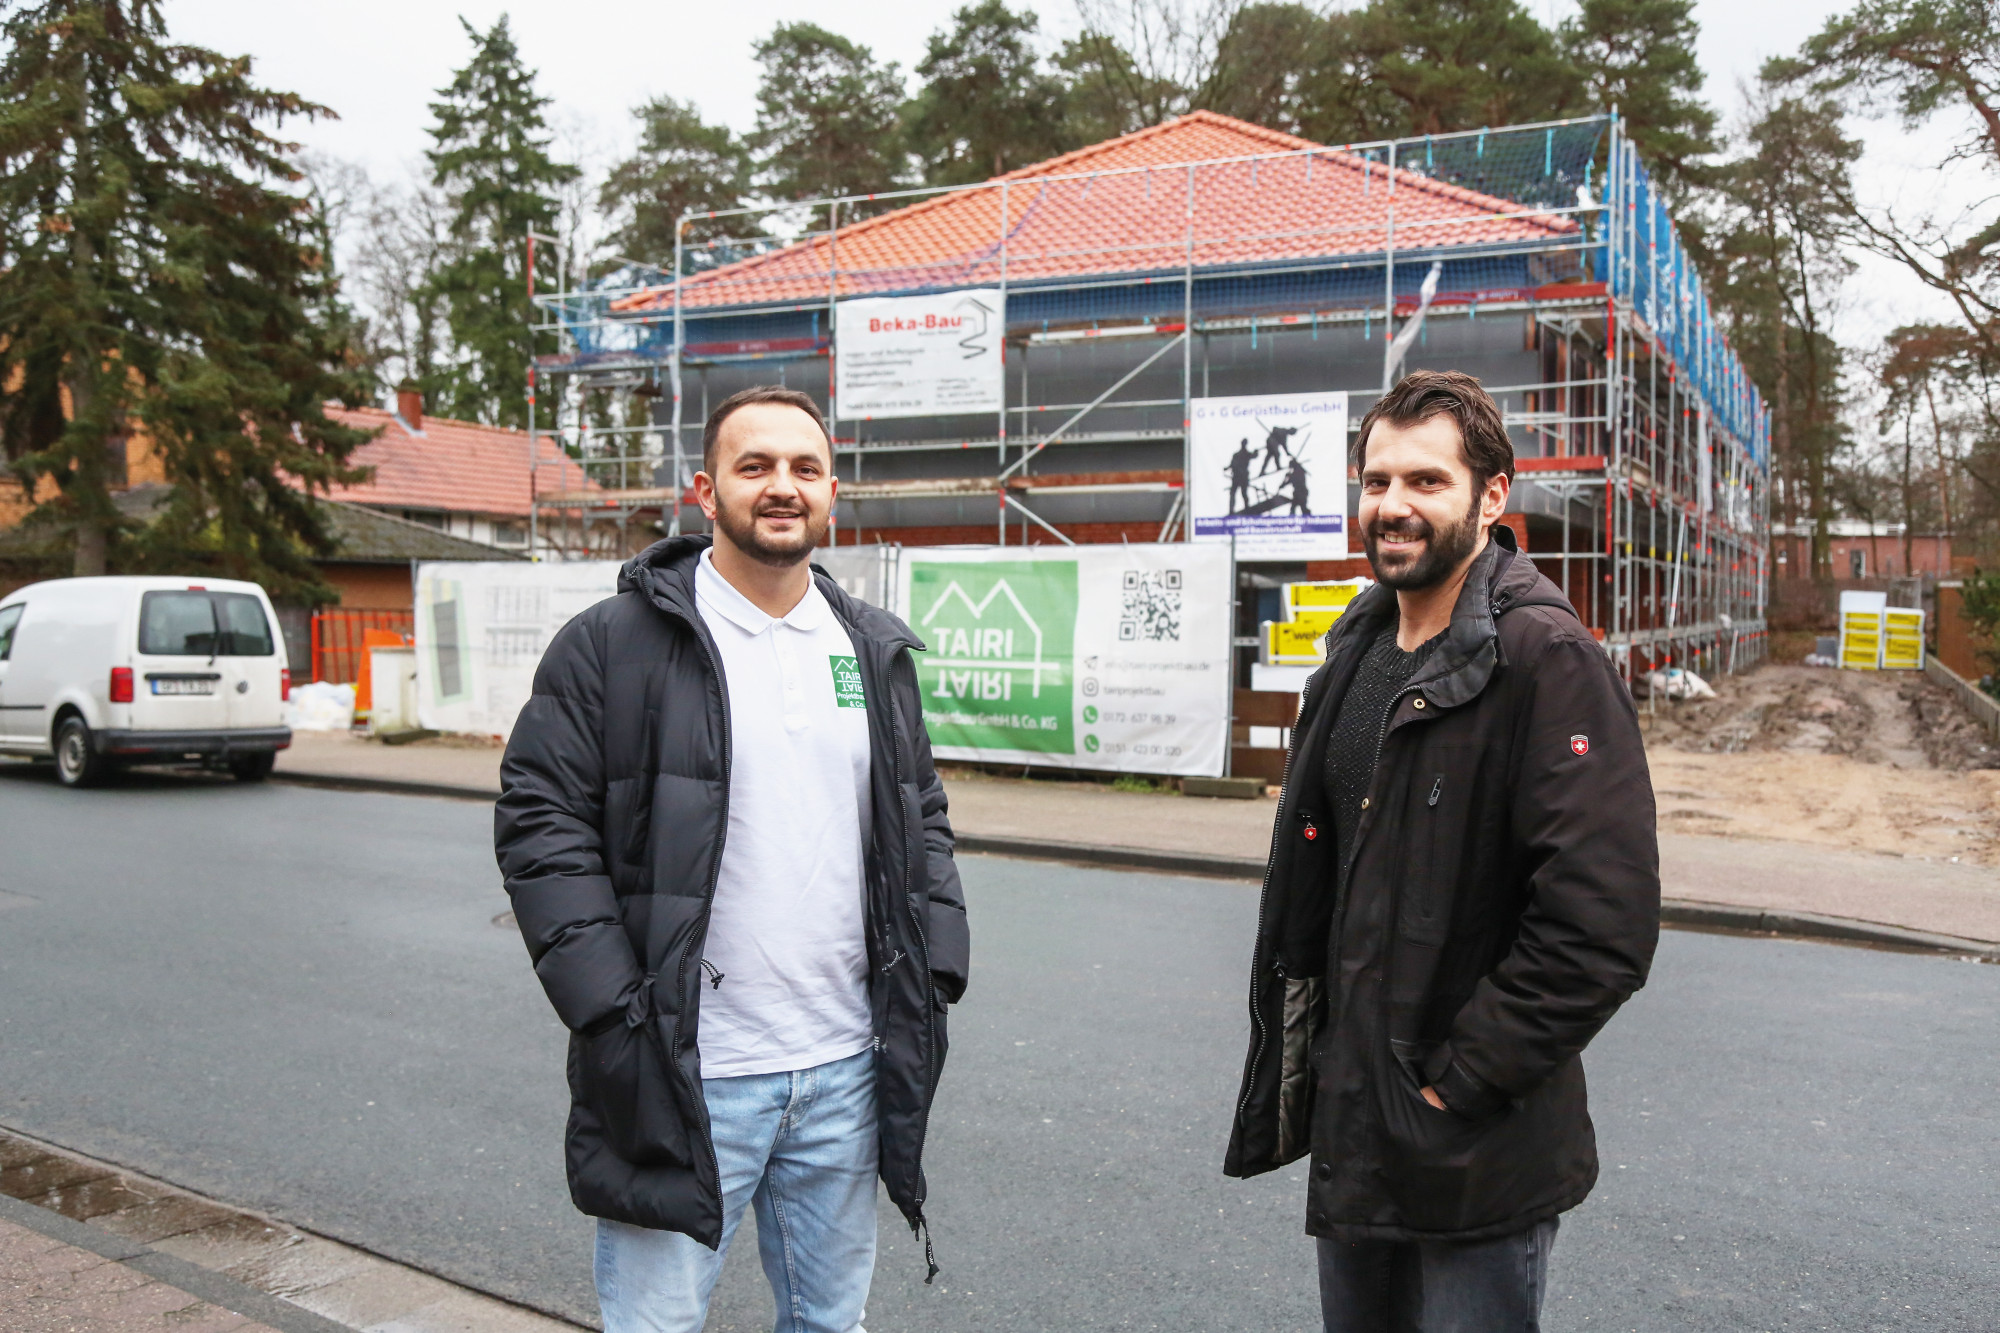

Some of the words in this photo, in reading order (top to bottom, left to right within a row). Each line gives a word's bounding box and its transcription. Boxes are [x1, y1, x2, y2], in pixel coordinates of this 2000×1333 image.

[869, 314, 962, 333] Beka-Bau
[1196, 407, 1206, 418] G
[1220, 406, 1229, 417] G
[1301, 402, 1342, 414] GmbH
[932, 628, 1013, 658] TAIRI
[838, 672, 862, 681] TAIR
[1011, 714, 1021, 729] &
[1021, 714, 1040, 730] Co.
[1040, 716, 1058, 731] KG
